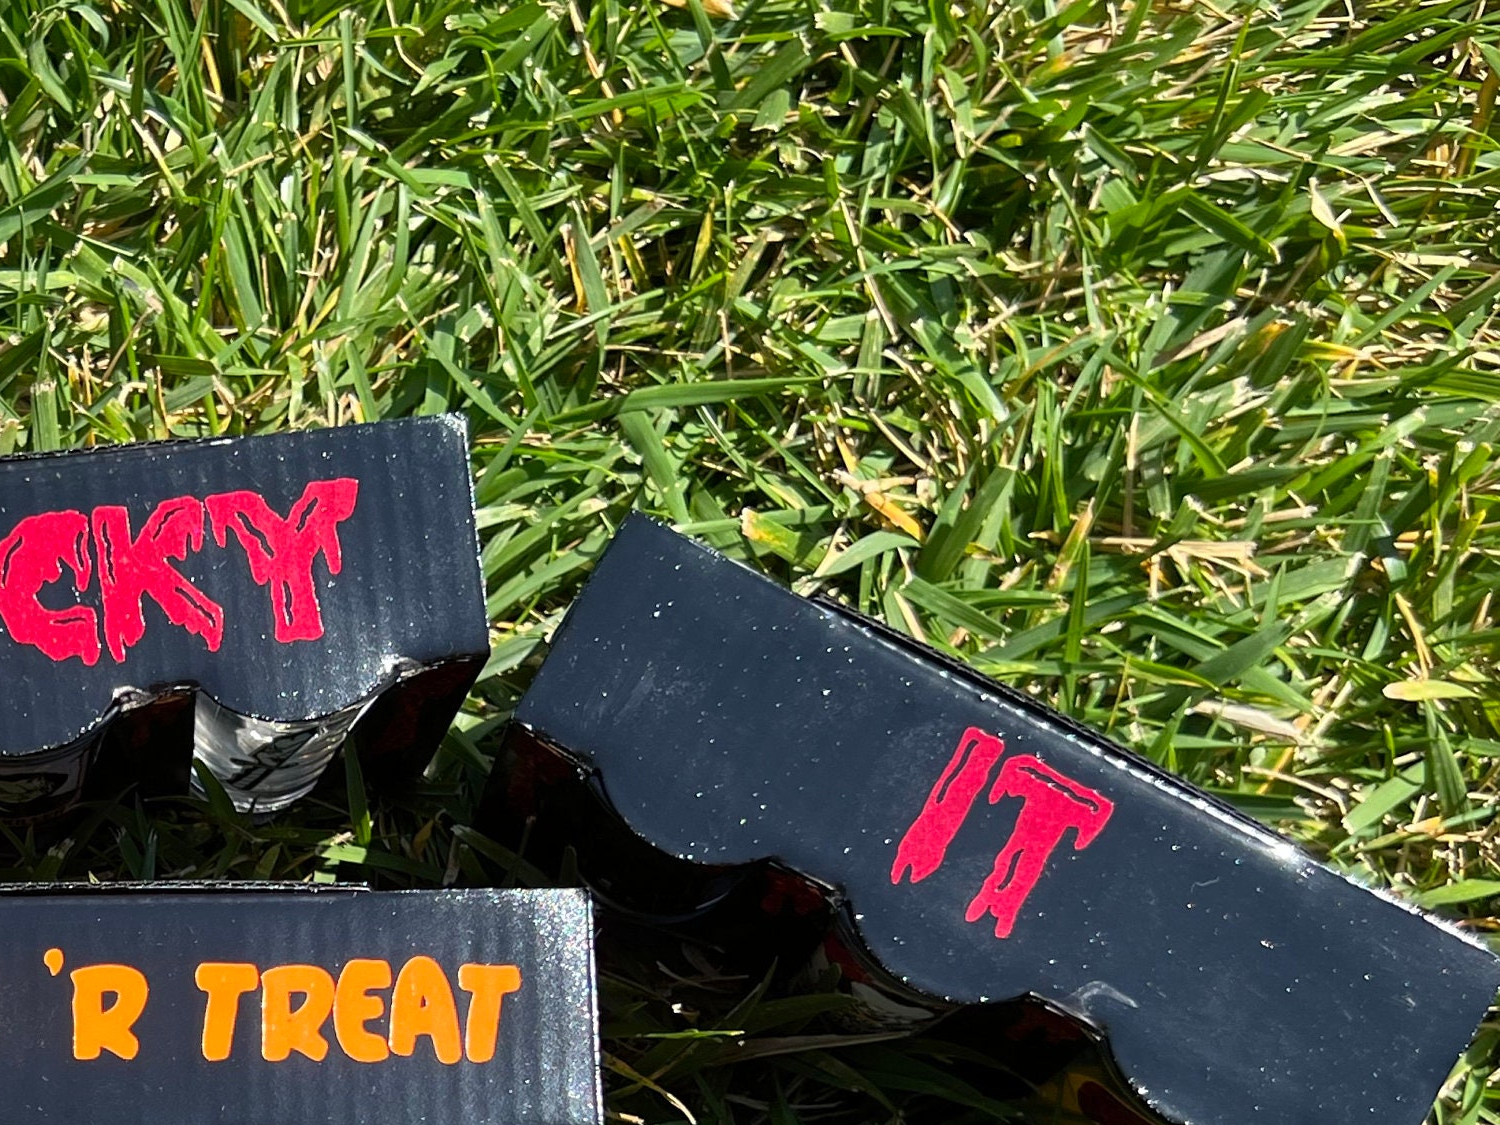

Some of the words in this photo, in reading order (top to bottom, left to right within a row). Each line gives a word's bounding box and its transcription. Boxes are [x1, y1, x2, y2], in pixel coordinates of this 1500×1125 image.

[893, 728, 1112, 937] IT
[44, 949, 149, 1060] 'R
[196, 957, 521, 1063] TREAT
